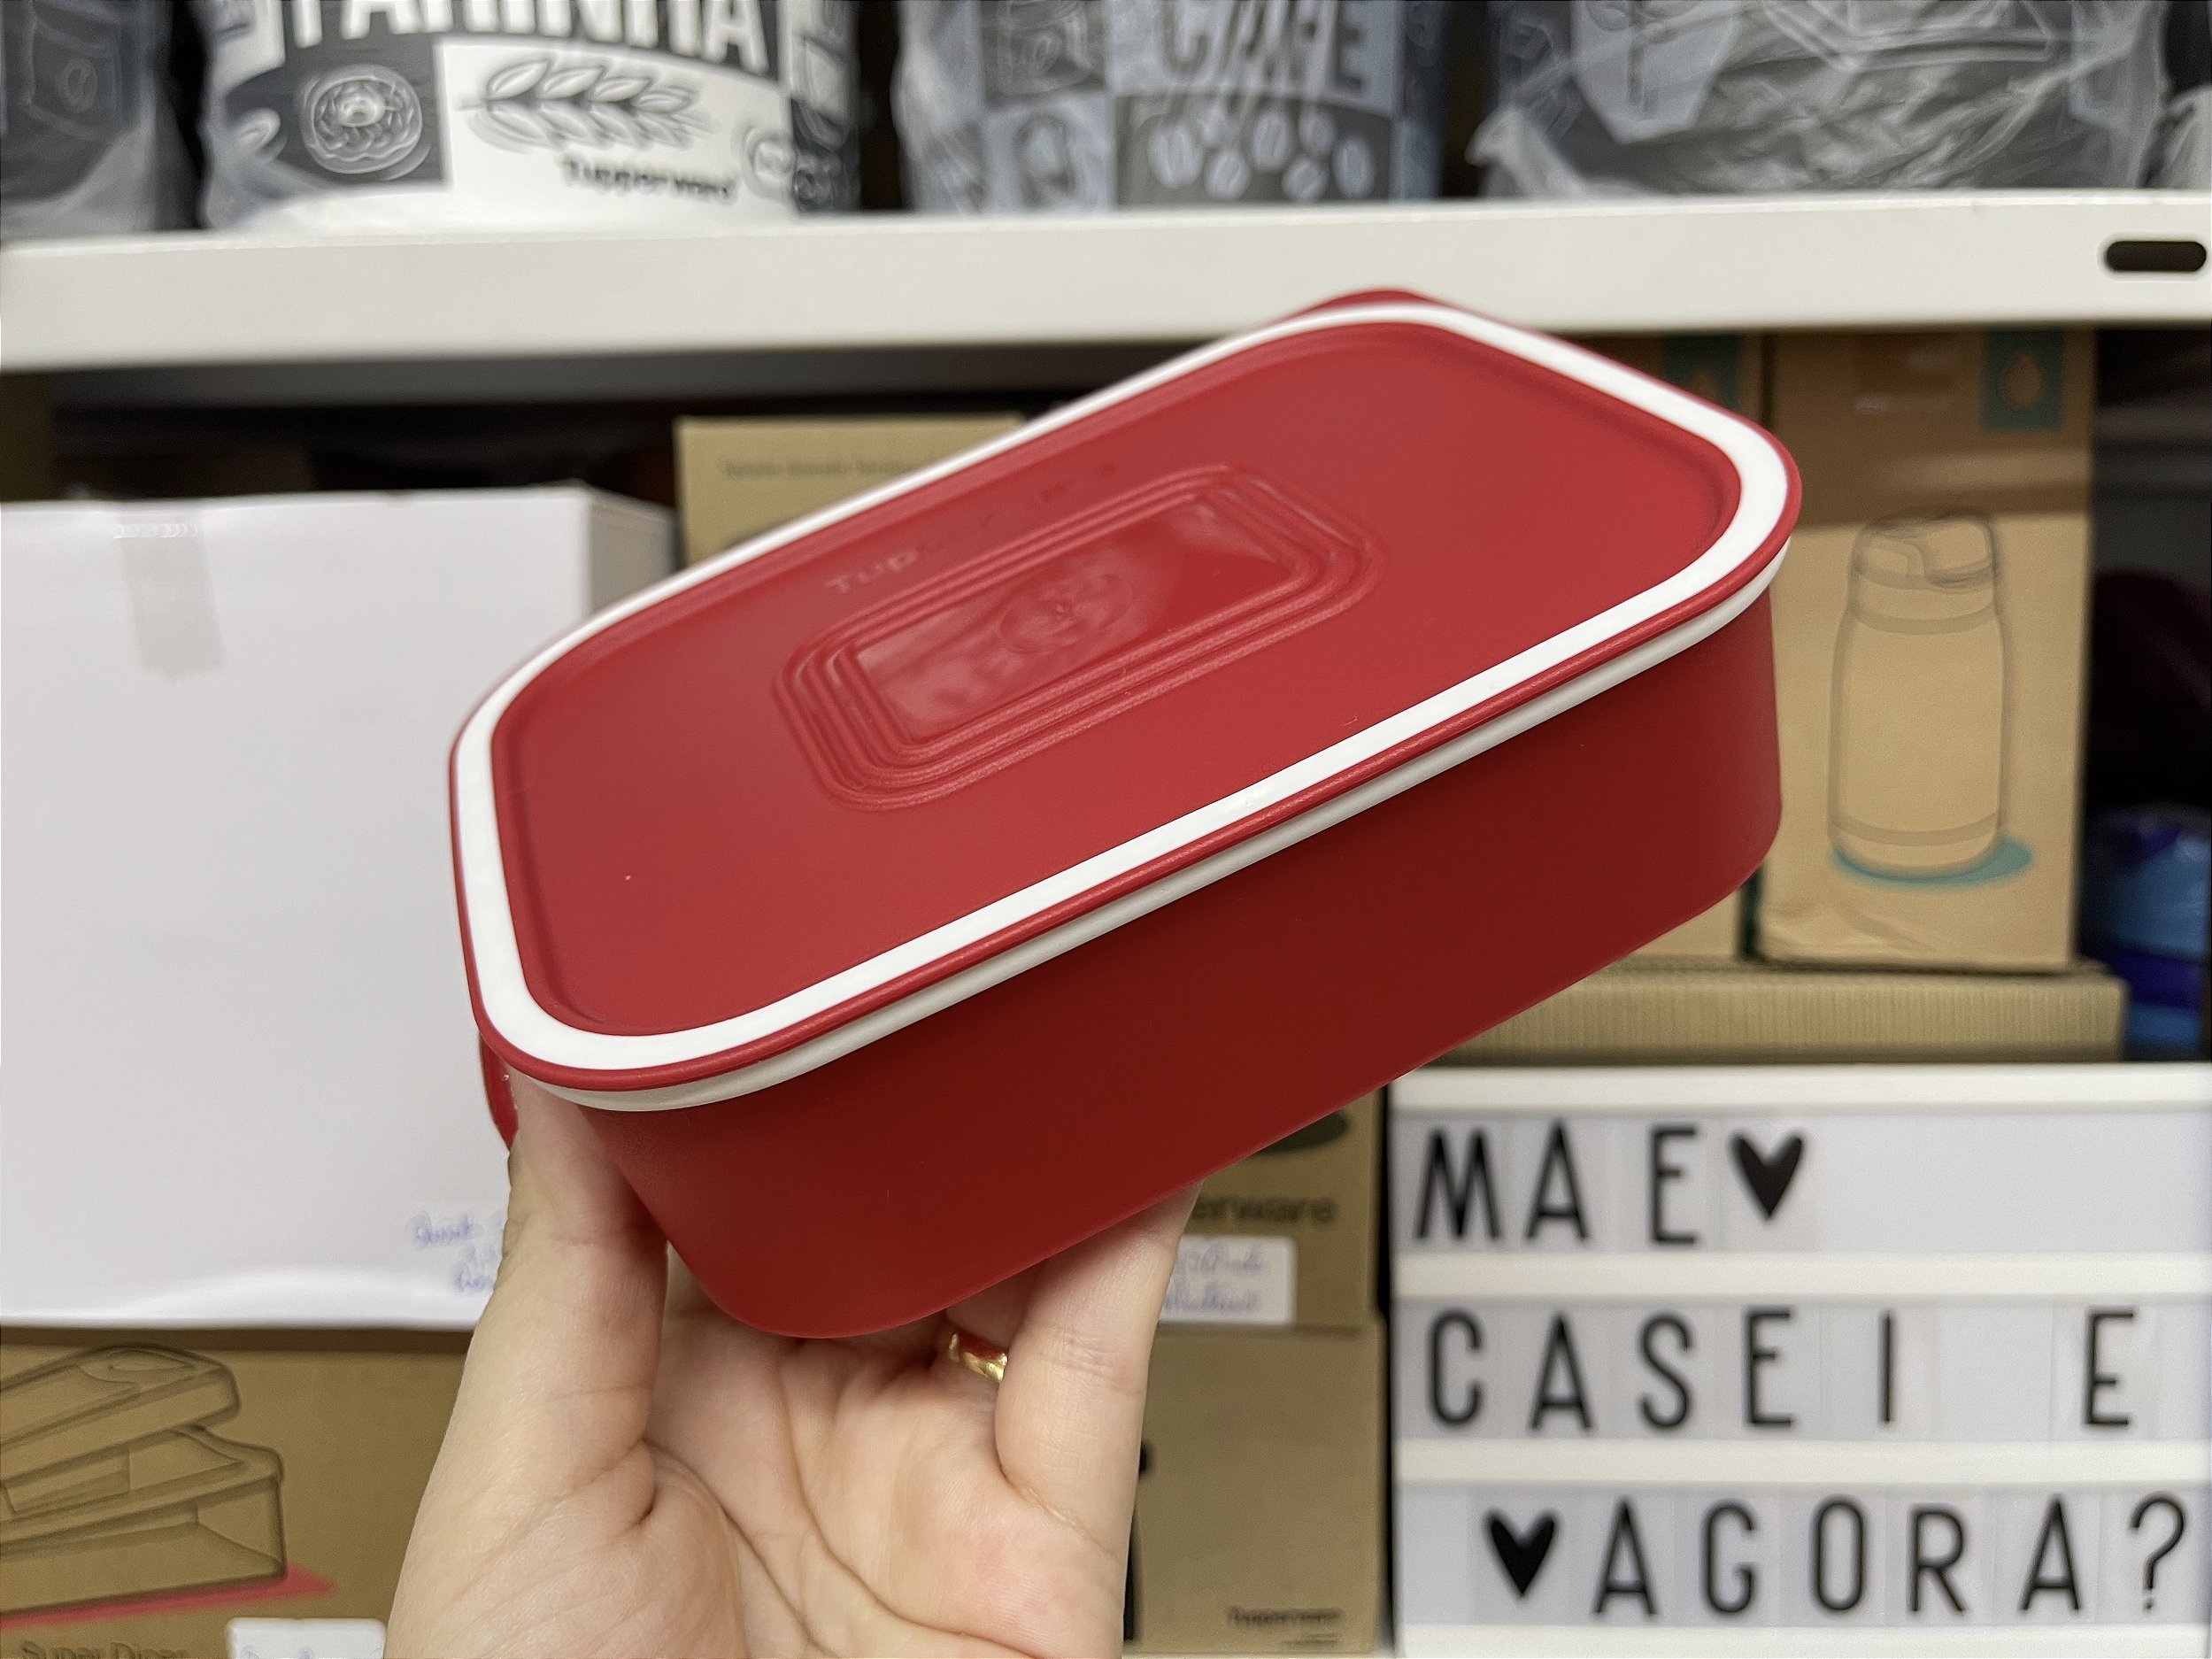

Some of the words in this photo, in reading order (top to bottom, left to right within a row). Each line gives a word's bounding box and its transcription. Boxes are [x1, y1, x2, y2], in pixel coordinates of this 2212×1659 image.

[1416, 1119, 1698, 1246] MAE
[1427, 1308, 1895, 1430] CASEI
[2083, 1307, 2134, 1427] E
[1594, 1493, 2188, 1617] AGORA?
